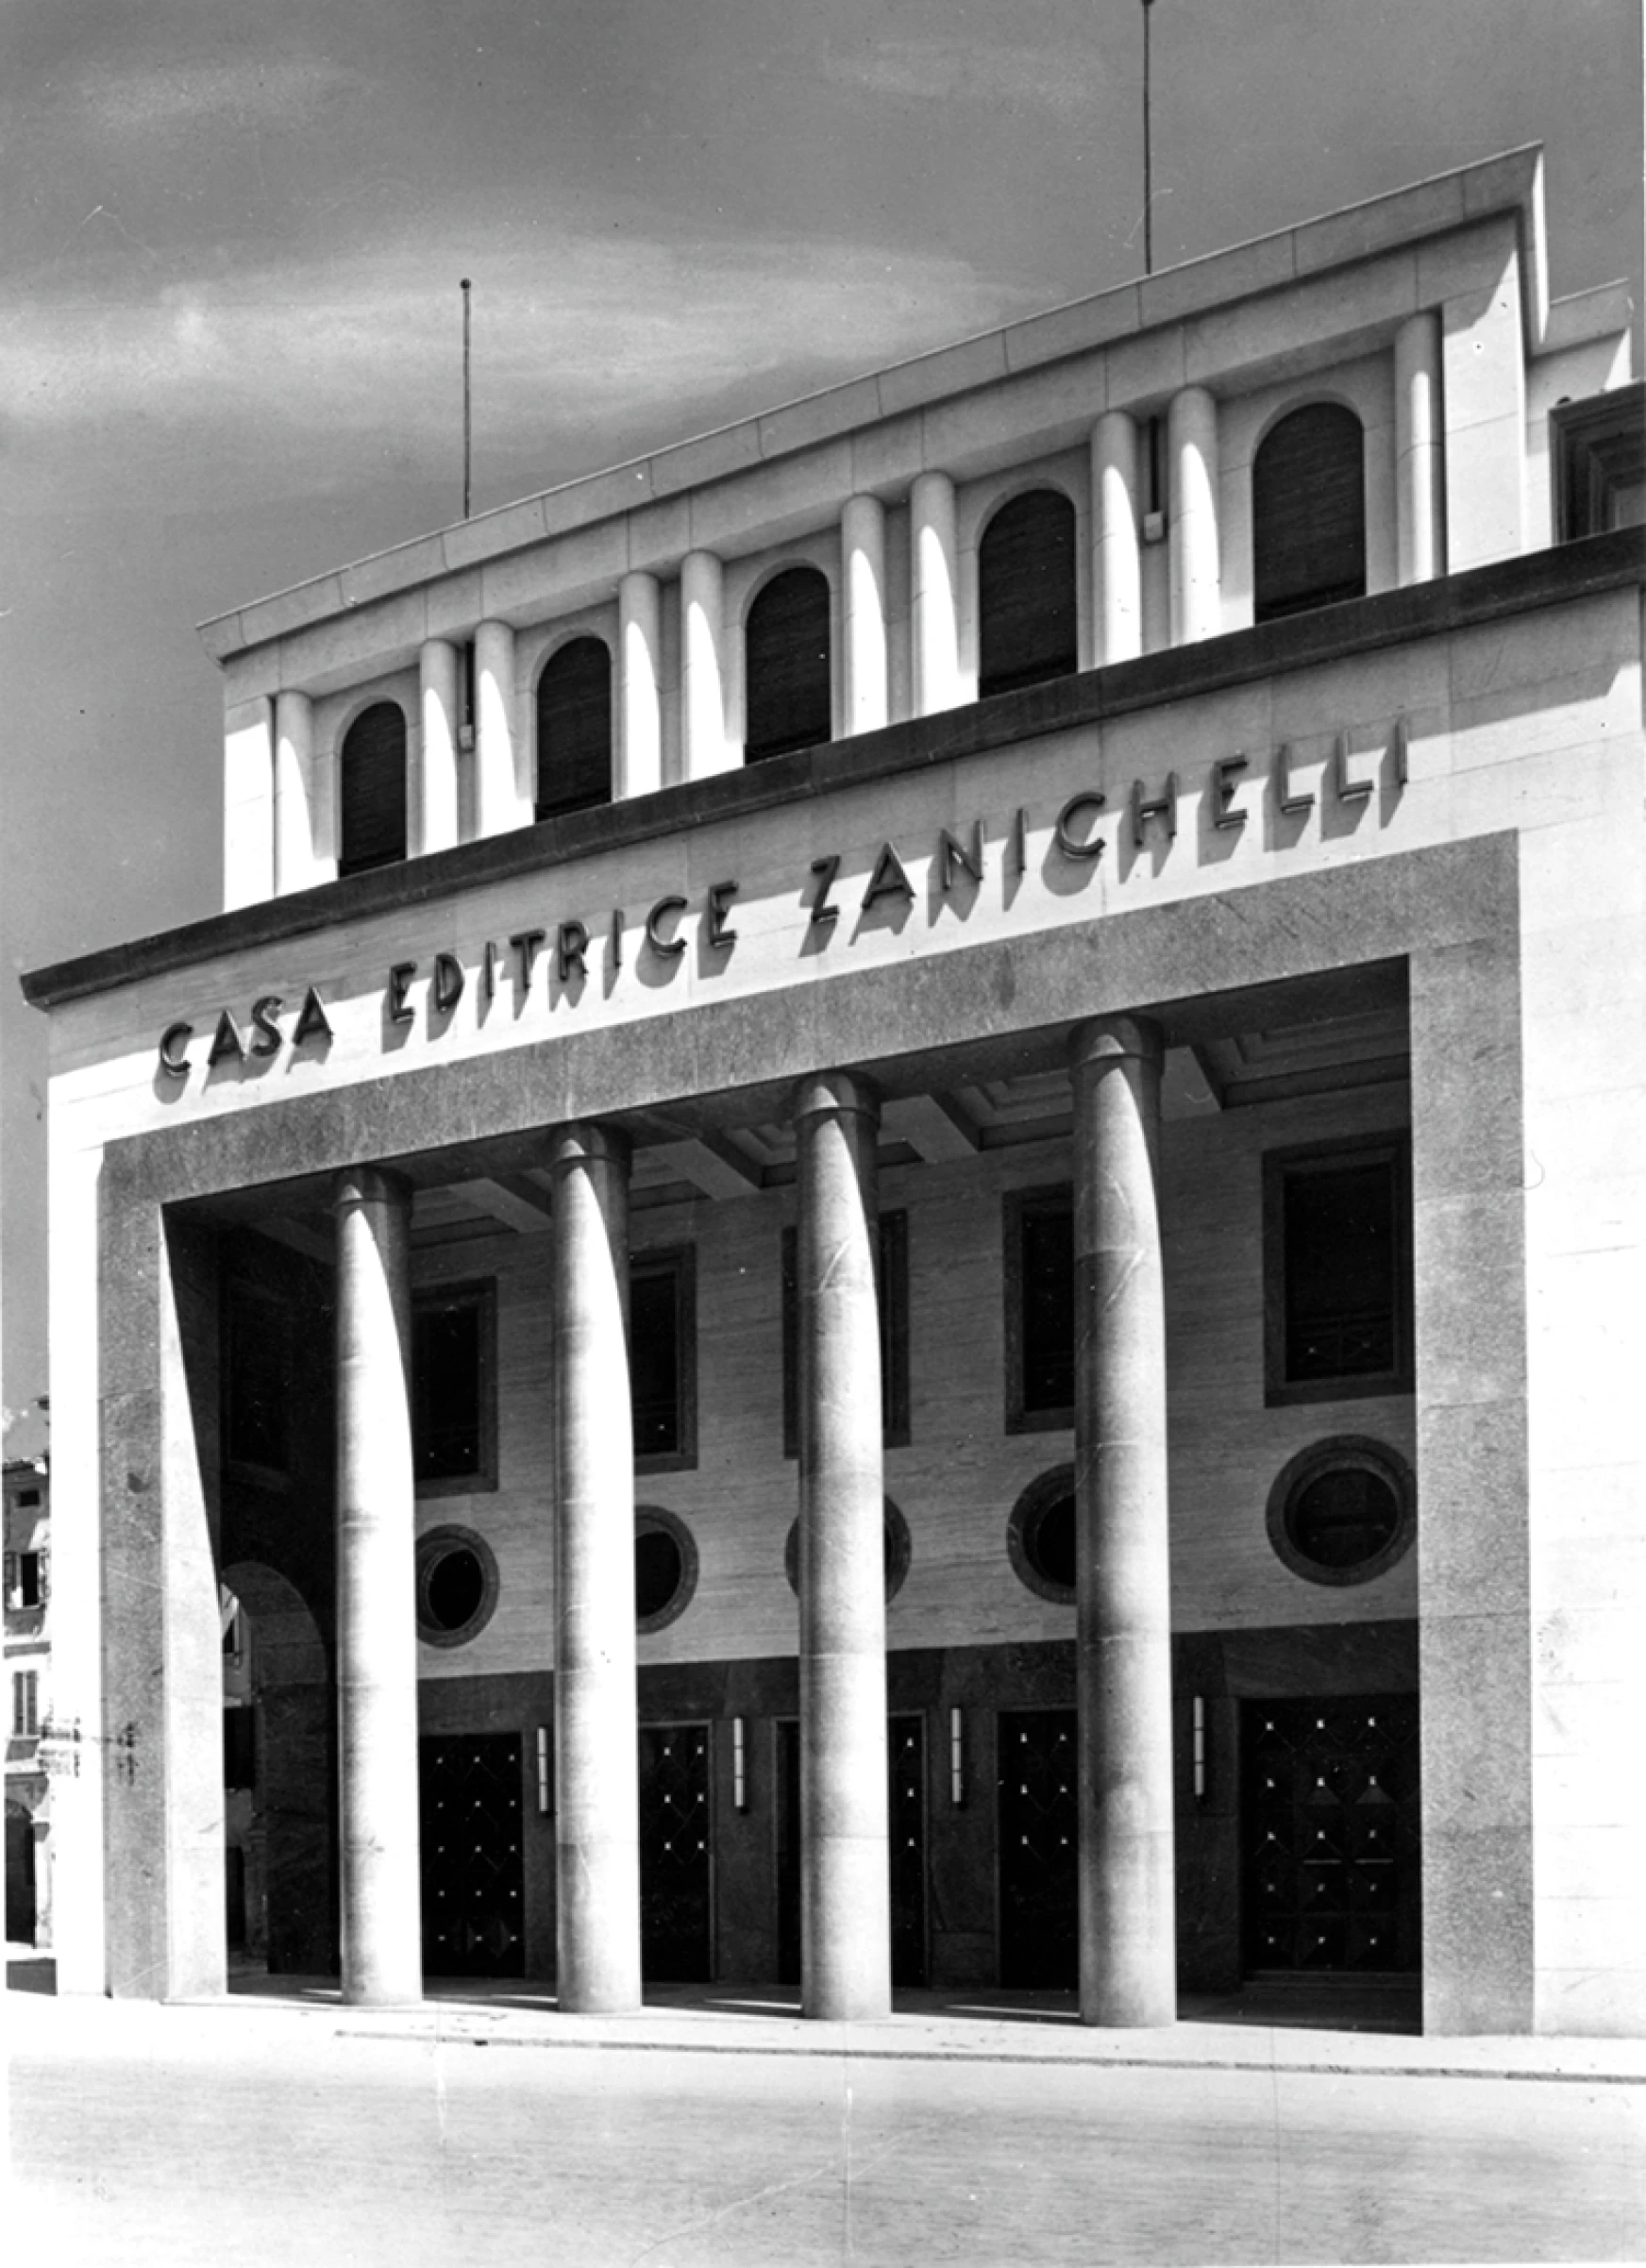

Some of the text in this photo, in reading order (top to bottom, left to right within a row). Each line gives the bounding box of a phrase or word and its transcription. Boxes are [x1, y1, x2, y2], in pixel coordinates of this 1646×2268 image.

[159, 718, 1408, 1073] CASA EDITRICE ZANICHELLI
